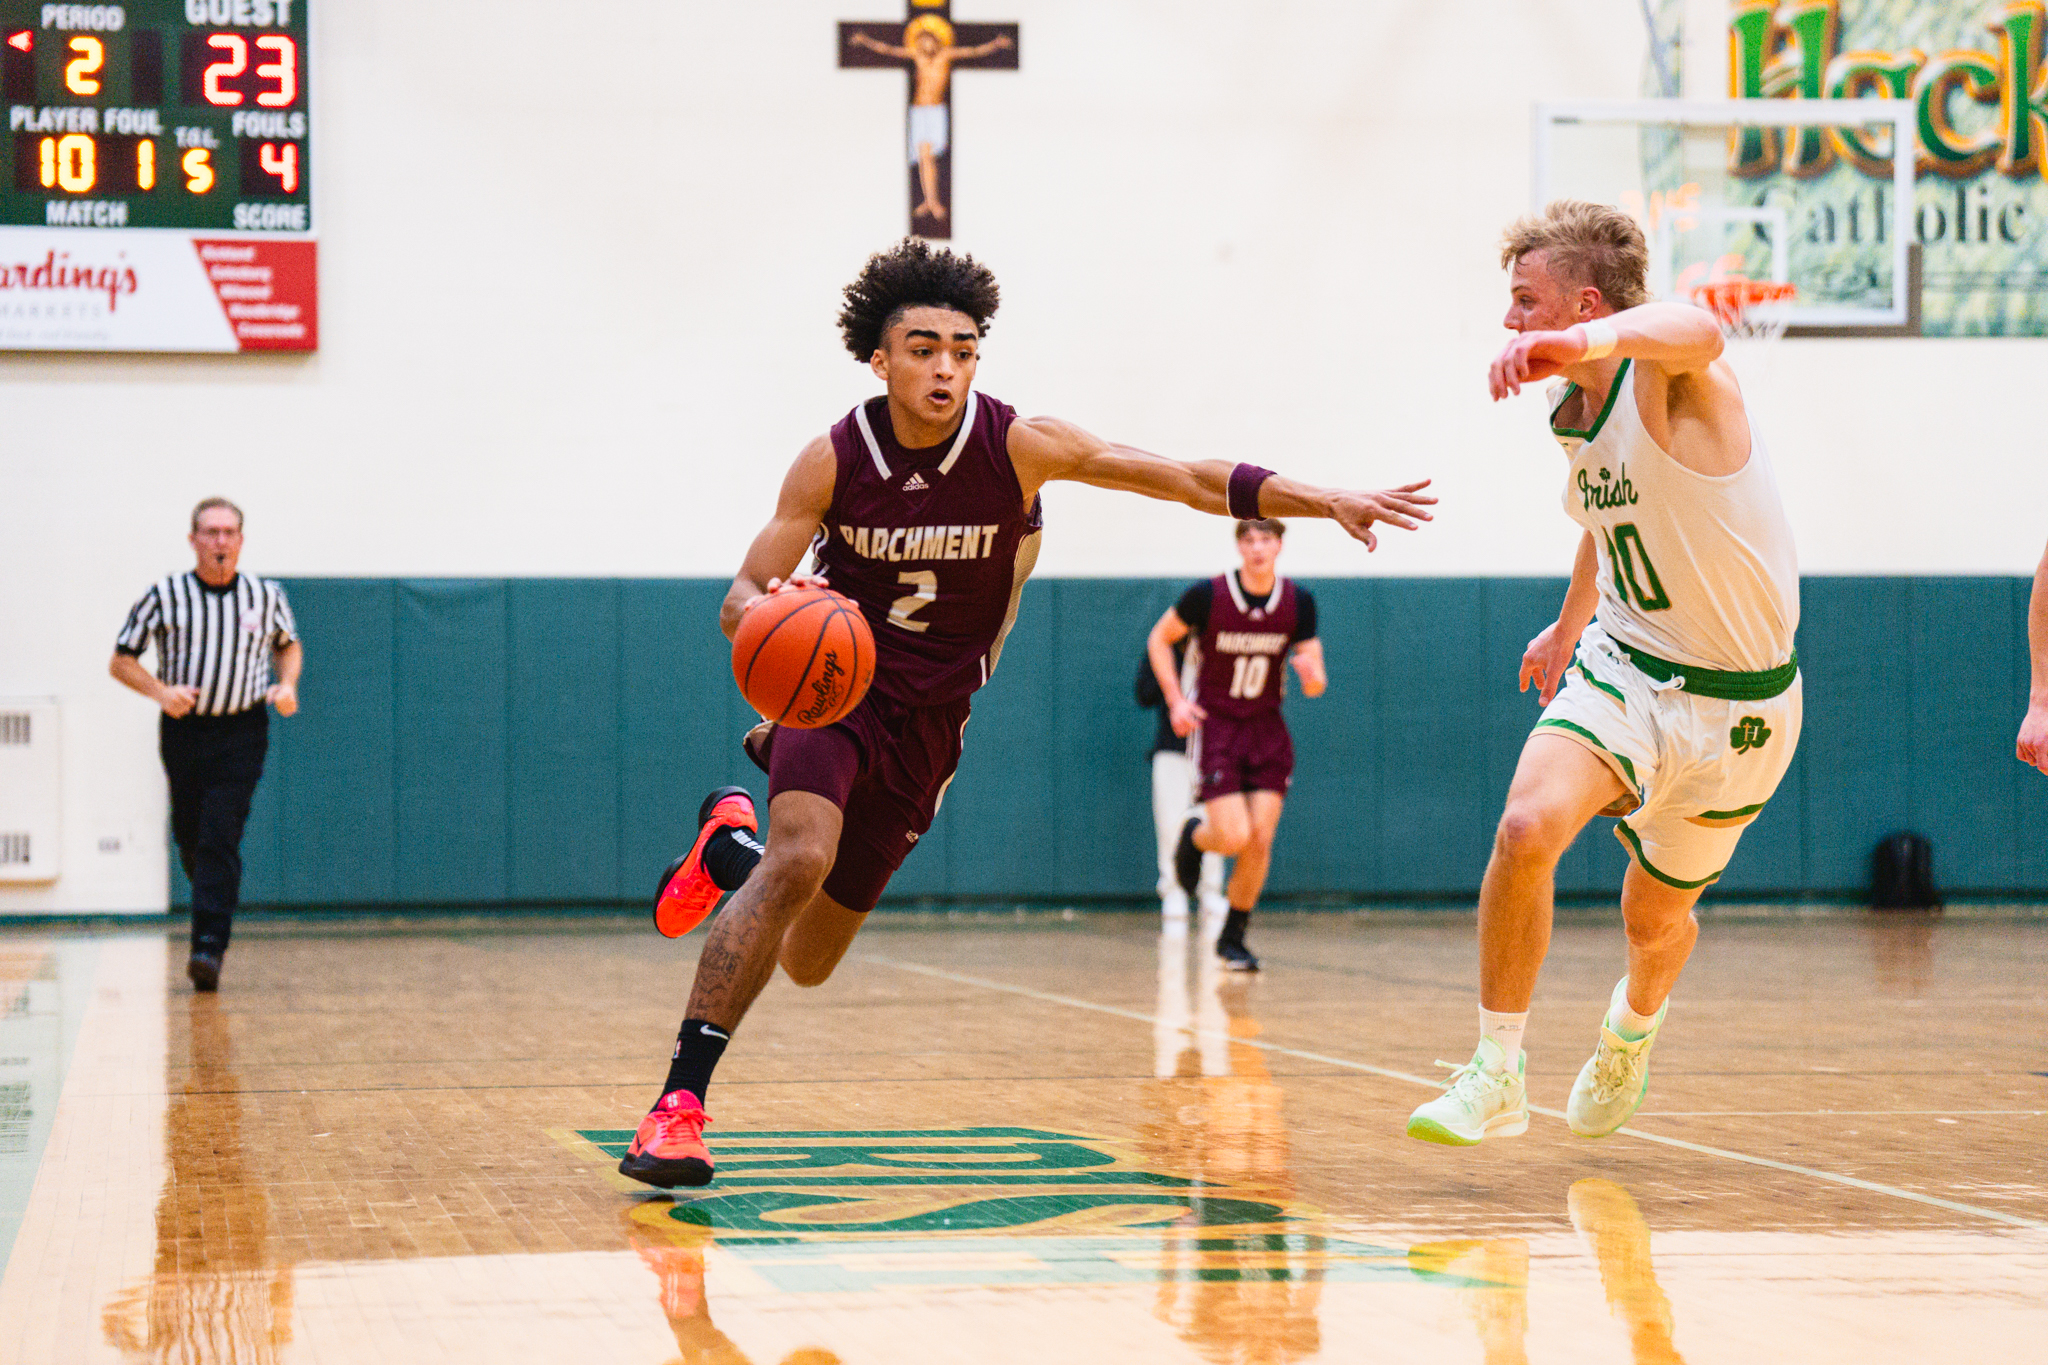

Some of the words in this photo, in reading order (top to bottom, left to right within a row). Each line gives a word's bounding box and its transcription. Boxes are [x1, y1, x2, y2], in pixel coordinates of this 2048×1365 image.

[41, 3, 126, 31] PERIOD
[185, 0, 289, 27] GUEST
[65, 35, 105, 96] 2
[203, 32, 298, 108] 23
[9, 105, 99, 133] PLAYER
[103, 107, 164, 136] FOUL
[231, 110, 306, 139] FOULS
[39, 132, 98, 194] 10
[136, 138, 156, 191] 1
[259, 141, 299, 194] 4
[45, 199, 129, 227] MATCH
[233, 202, 308, 230] SCORE
[902, 482, 929, 491] adidas
[1577, 462, 1639, 512] Irish
[839, 524, 999, 562] PARCHMENT
[886, 569, 938, 633] 2
[797, 650, 845, 725] Rawlings
[1228, 655, 1271, 699] 10
